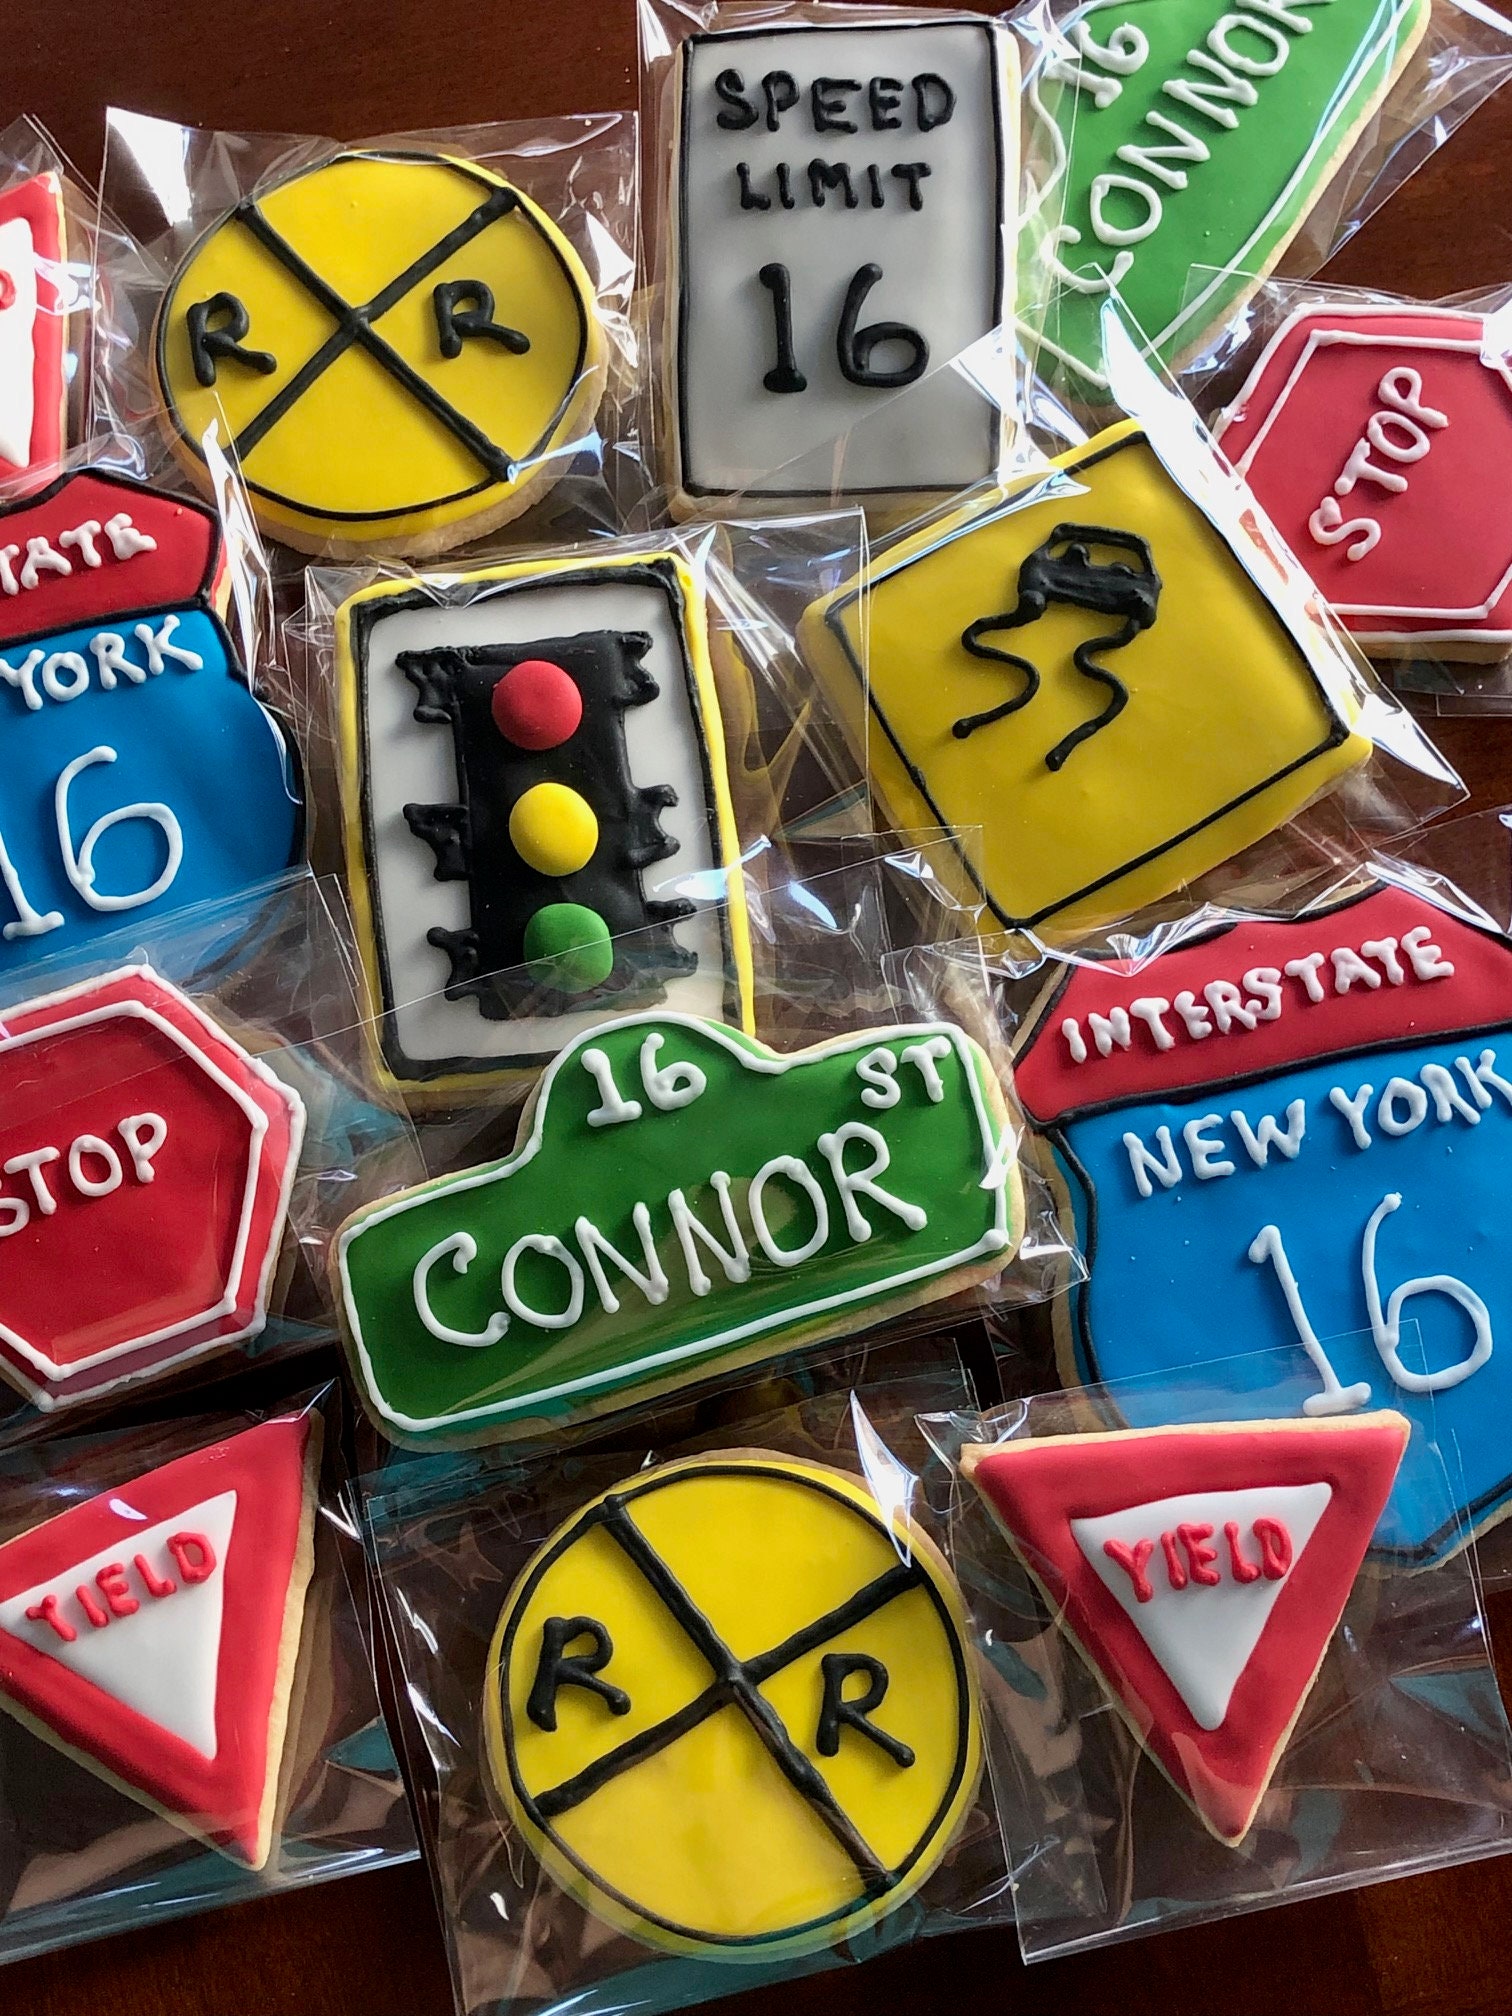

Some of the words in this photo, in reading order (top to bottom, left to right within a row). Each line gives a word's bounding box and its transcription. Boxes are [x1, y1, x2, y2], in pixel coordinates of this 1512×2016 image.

[714, 68, 957, 134] SPEED
[1042, 20, 1150, 108] 16
[736, 157, 932, 212] LIMIT
[187, 291, 277, 387] R
[433, 279, 531, 360] R
[758, 262, 931, 394] 16
[1308, 366, 1450, 563] STOP
[0, 512, 158, 596] TATE
[0, 614, 204, 711] YORK
[0, 745, 184, 941] 16
[1061, 926, 1456, 1064] INTERSTATE
[581, 1032, 708, 1128] 16
[854, 1035, 953, 1110] ST
[1122, 1098, 1306, 1198] NEW
[1328, 1048, 1512, 1151] YORK
[412, 1121, 928, 1347] CONNOR
[1248, 1191, 1494, 1416] 16
[26, 1531, 218, 1643] YIELD
[1103, 1517, 1294, 1603] YIELD
[526, 1615, 632, 1732] R
[815, 1652, 917, 1768] R
